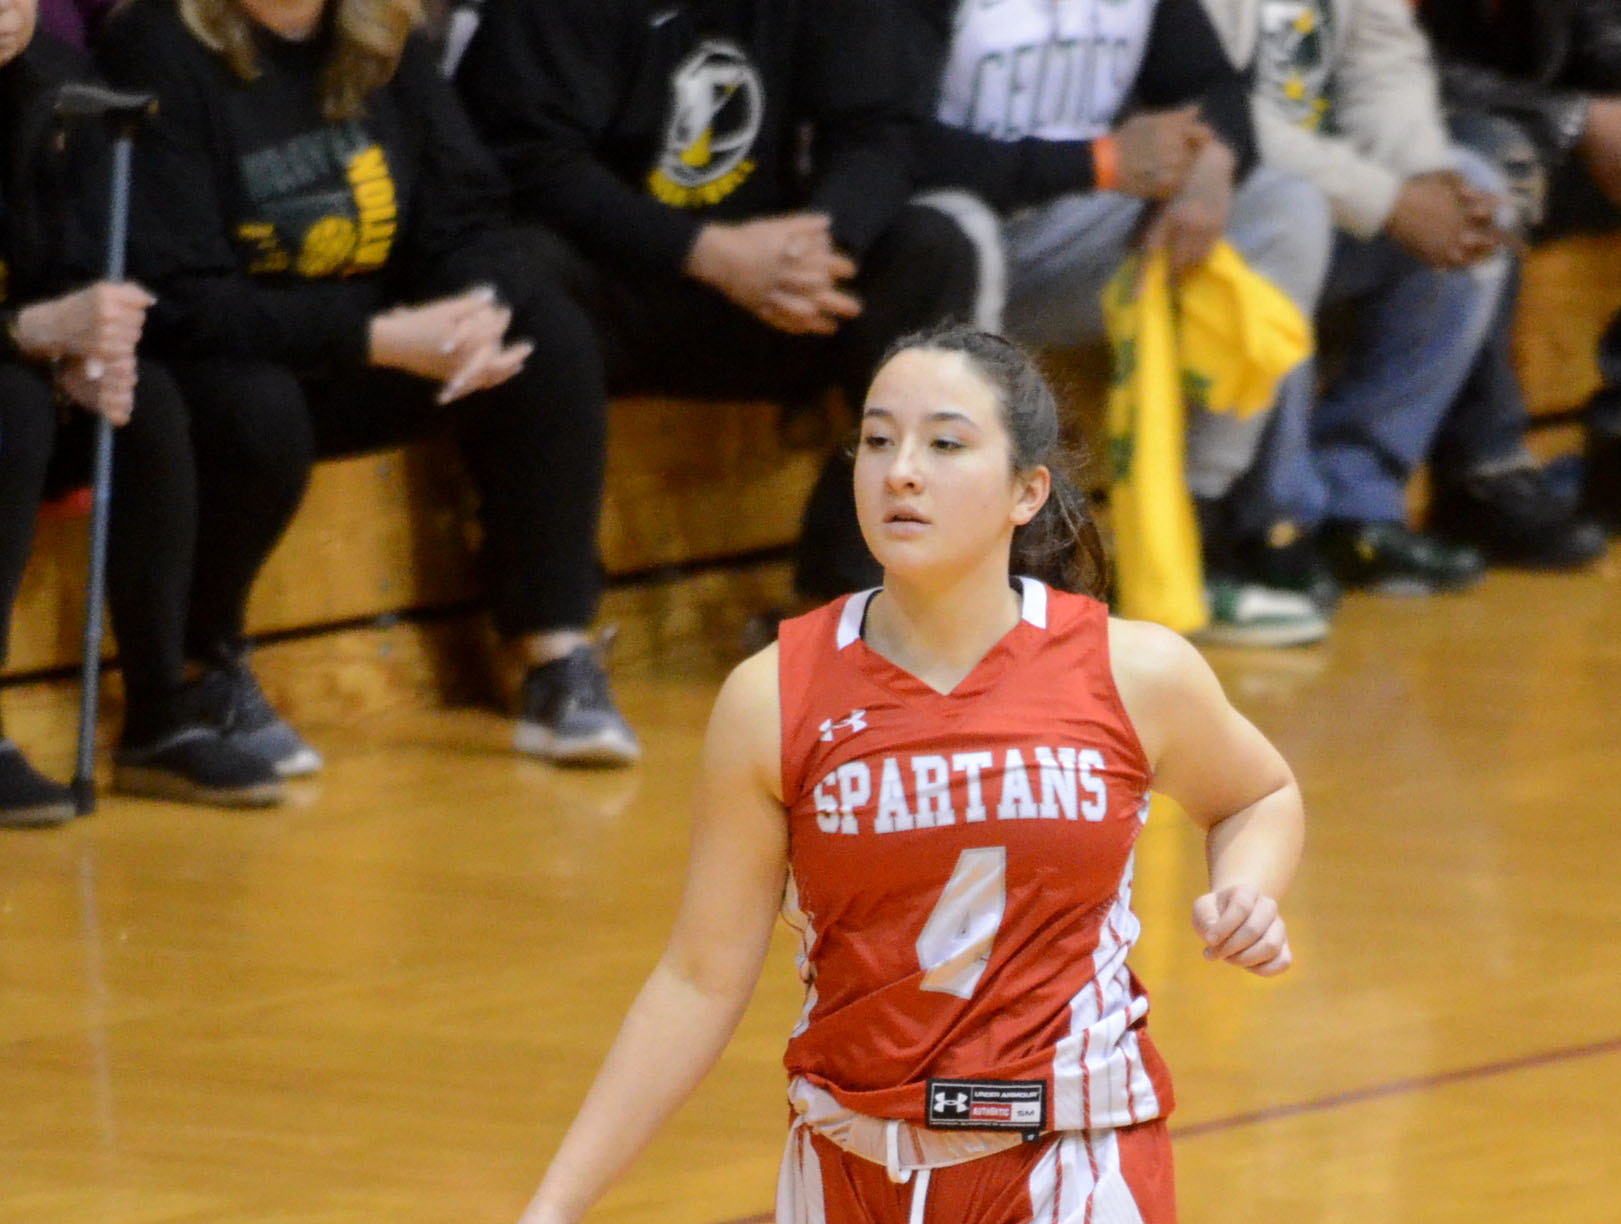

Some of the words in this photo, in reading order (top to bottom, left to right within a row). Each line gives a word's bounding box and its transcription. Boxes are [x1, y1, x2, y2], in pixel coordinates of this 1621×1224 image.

[813, 746, 1108, 835] SPARTANS
[915, 845, 1007, 1000] 4
[1001, 1091, 1039, 1099] ARMOUR
